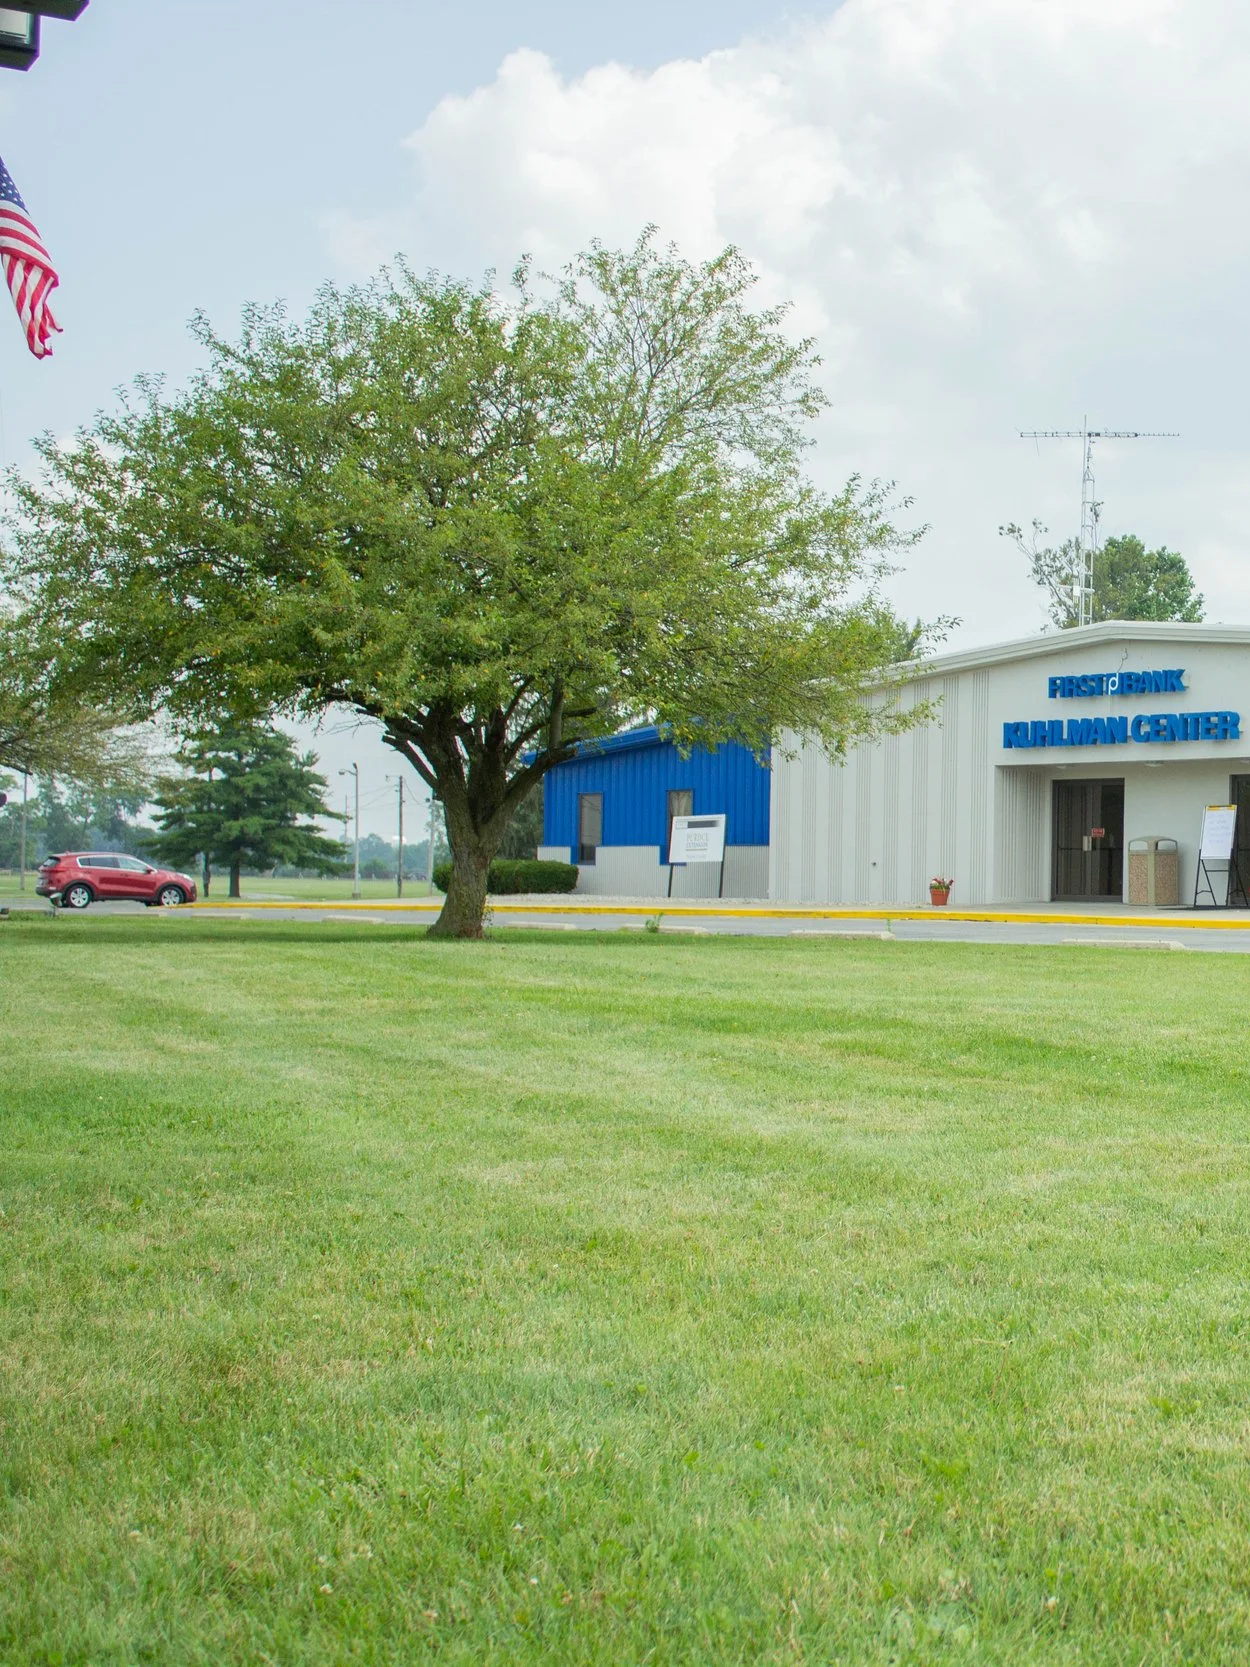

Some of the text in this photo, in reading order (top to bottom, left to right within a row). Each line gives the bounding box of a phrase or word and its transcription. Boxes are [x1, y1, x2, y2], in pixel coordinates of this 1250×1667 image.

[1048, 669, 1186, 698] FIRST BANK
[1003, 711, 1240, 748] KUHLMAN CENTER
